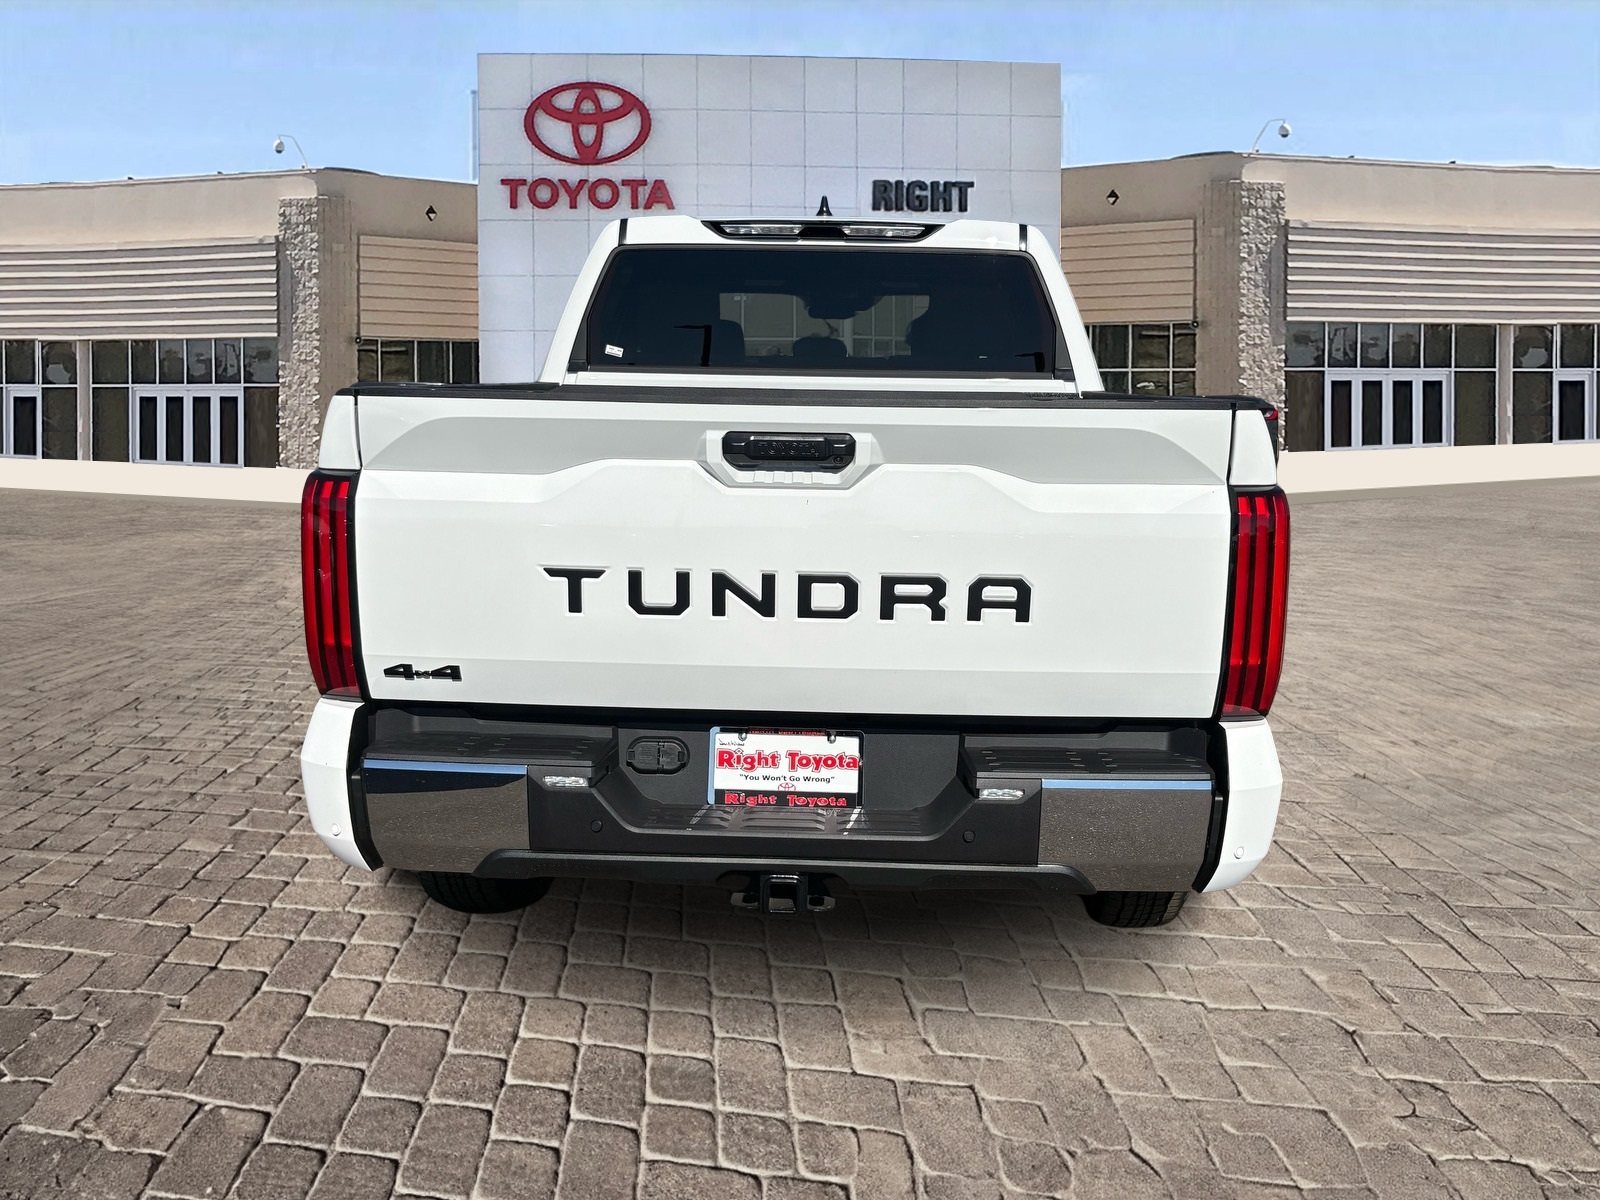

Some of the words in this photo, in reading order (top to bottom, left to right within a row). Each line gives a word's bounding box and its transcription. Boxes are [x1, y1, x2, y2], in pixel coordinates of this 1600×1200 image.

[500, 178, 675, 211] TOYOTA
[871, 178, 975, 213] RIGHT
[757, 441, 819, 458] TOYOTA
[541, 565, 1034, 623] TUNDRA
[716, 748, 781, 772] Right
[786, 750, 859, 773] Toyota
[739, 774, 760, 782] "You
[803, 776, 835, 784] Wrong"
[724, 793, 777, 807] Right
[787, 794, 847, 808] Toyota
